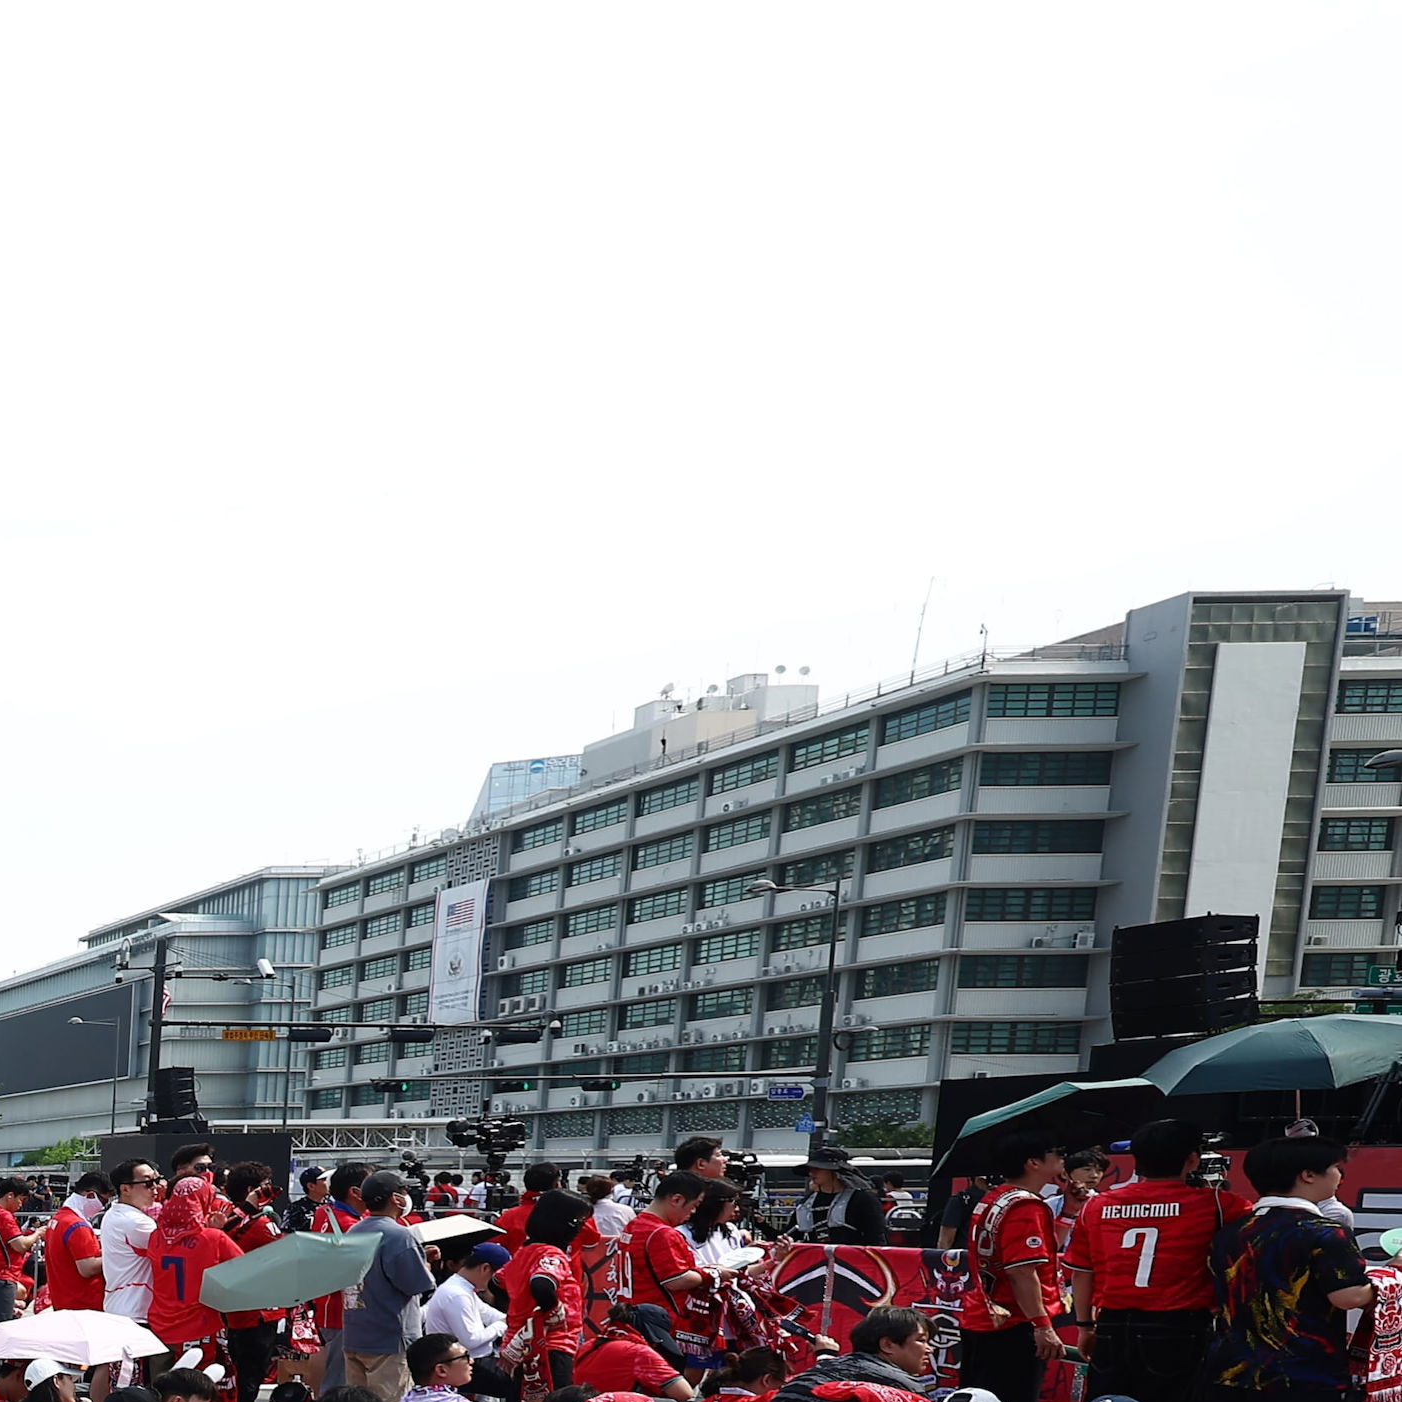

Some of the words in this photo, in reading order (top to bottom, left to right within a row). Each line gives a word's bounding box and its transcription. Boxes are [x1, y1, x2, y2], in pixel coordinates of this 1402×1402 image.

[1100, 1202, 1181, 1220] HEUNGMIN
[161, 1255, 185, 1302] 7
[1120, 1226, 1159, 1288] 7
